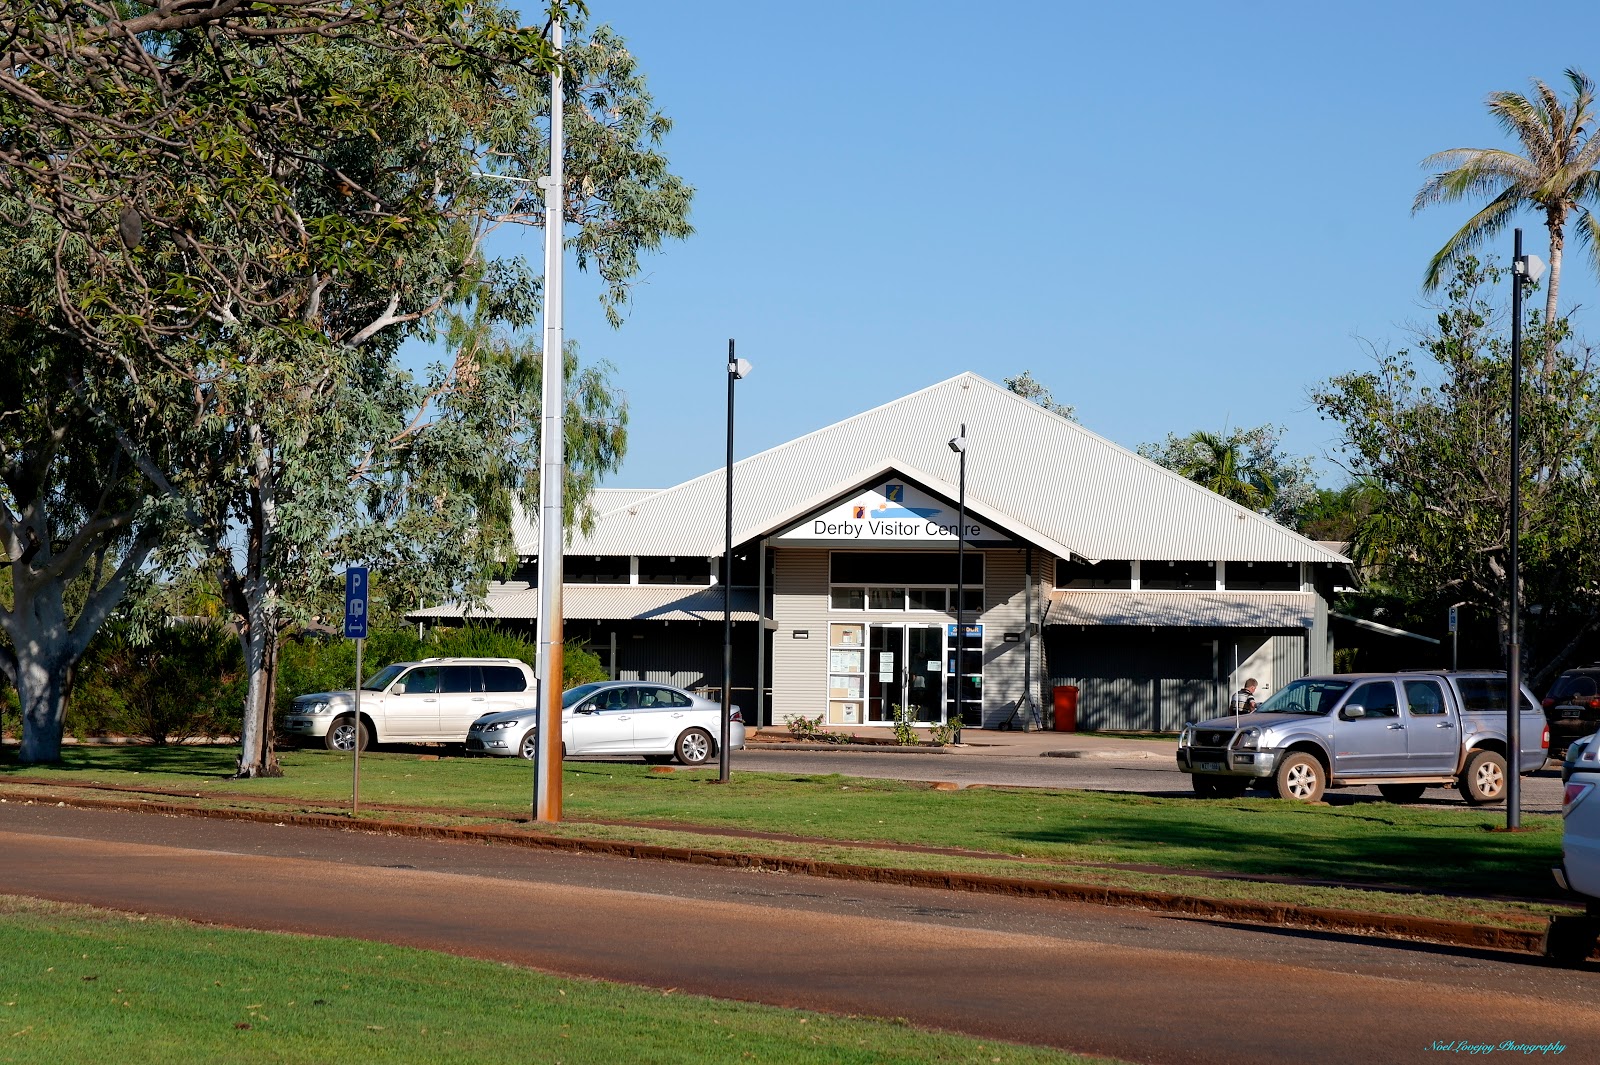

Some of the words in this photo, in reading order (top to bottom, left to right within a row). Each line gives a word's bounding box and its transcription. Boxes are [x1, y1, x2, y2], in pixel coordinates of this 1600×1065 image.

[814, 520, 863, 538] Derby
[868, 520, 920, 536] Visitor
[925, 521, 981, 536] Cenre
[352, 573, 361, 594] P
